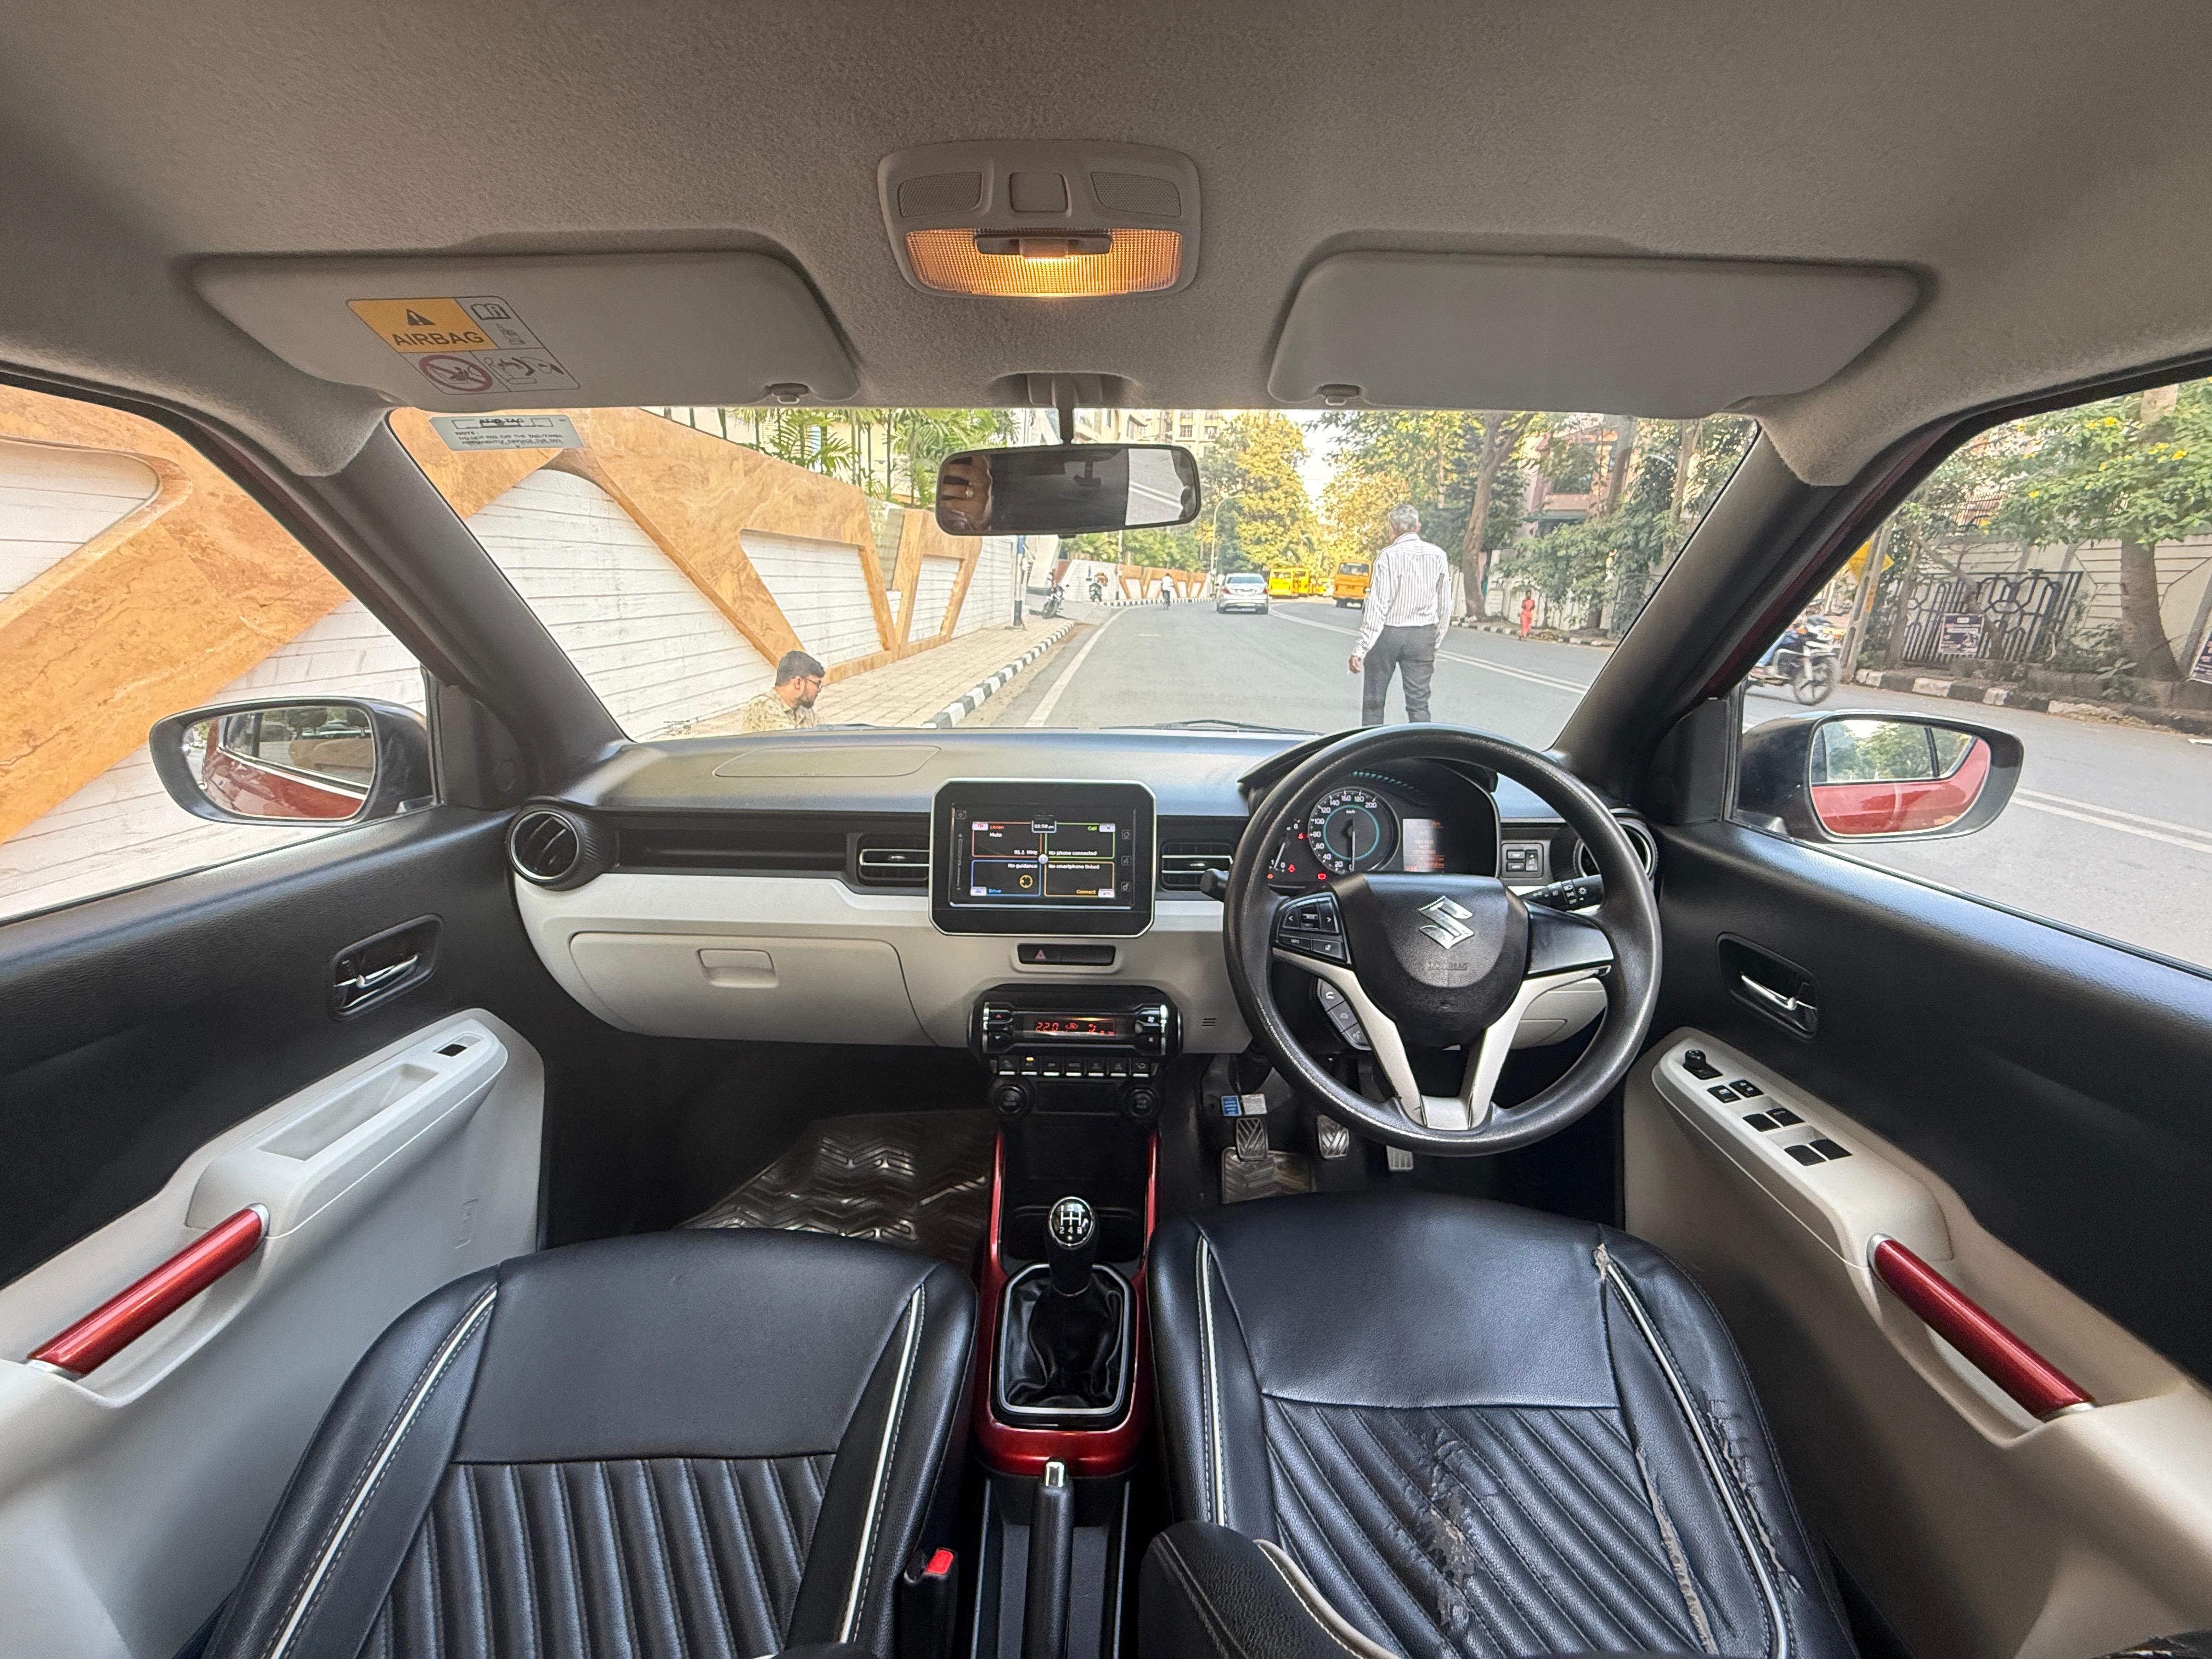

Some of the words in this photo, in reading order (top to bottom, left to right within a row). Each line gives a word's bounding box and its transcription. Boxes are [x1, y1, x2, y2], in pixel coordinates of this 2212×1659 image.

[392, 331, 484, 346] AIRBAG
[1059, 1226, 1065, 1234] 2
[1077, 1226, 1082, 1234] R
